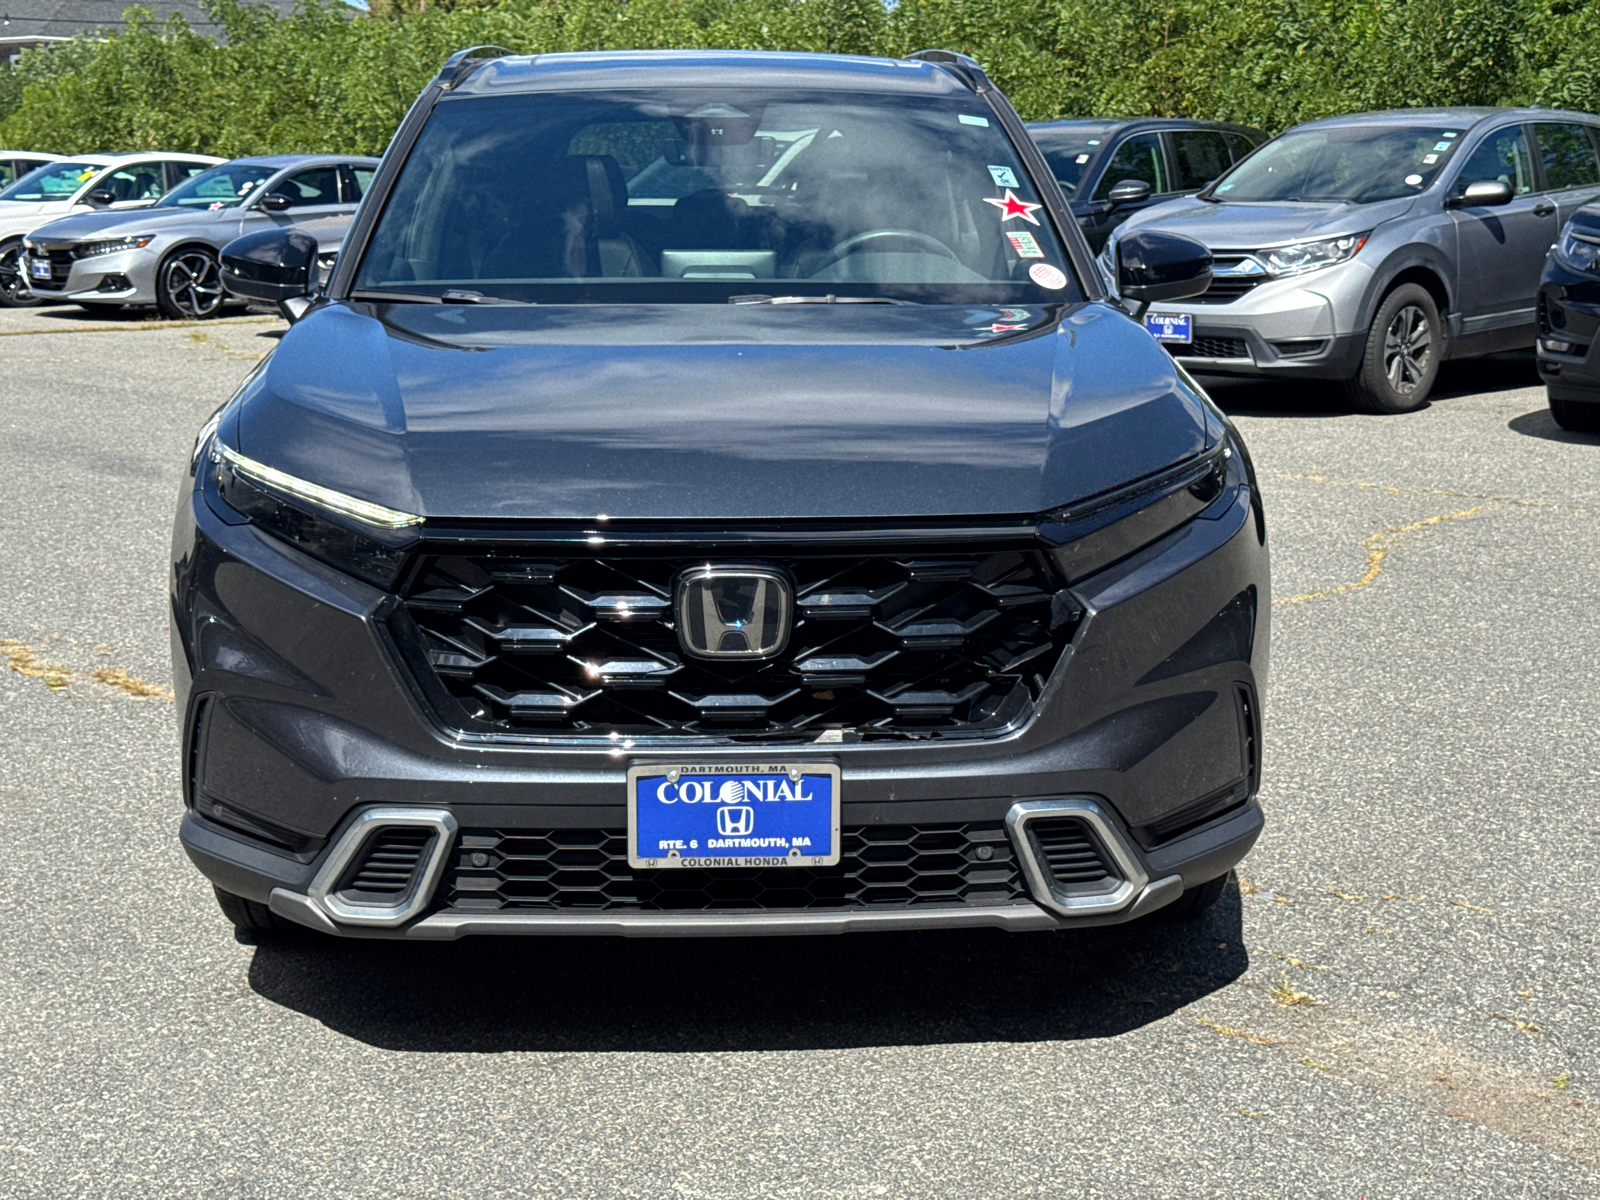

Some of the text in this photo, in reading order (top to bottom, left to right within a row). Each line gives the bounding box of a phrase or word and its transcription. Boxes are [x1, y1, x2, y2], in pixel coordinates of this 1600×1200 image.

[680, 765, 787, 774] DARTMOUTH, MA
[656, 779, 813, 804] COLONIAL
[658, 837, 812, 849] RTE. 6 DARTMOUTH, MA
[681, 857, 788, 867] COLONIAL HONDA
